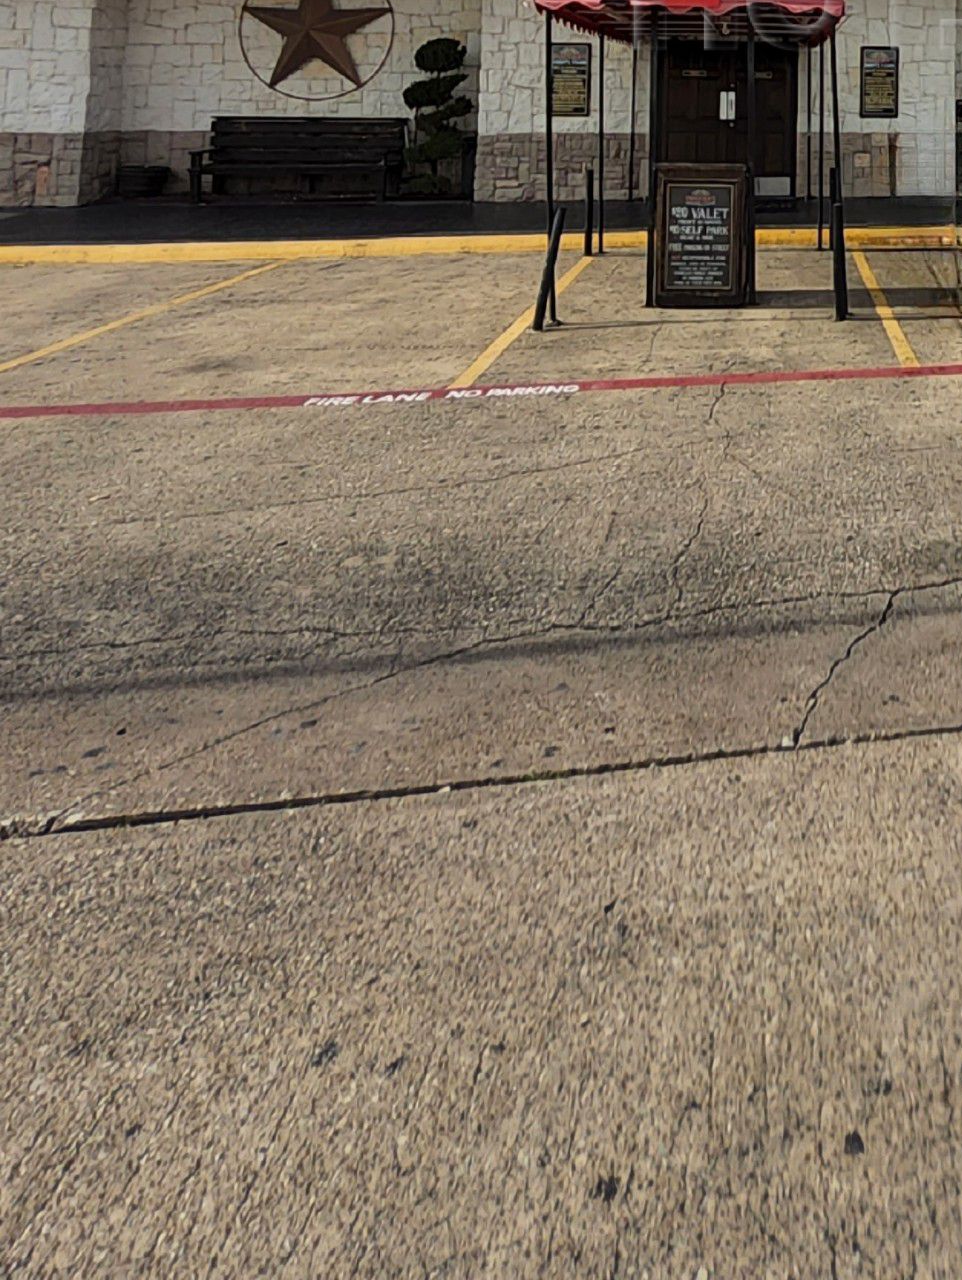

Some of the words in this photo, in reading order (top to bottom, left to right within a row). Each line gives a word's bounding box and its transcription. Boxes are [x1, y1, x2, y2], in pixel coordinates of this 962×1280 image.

[691, 207, 729, 220] VALET
[681, 225, 704, 235] SELF
[706, 225, 729, 236] PARK
[303, 395, 360, 407] FIRE
[361, 391, 433, 404] LANE
[445, 389, 483, 400] NO
